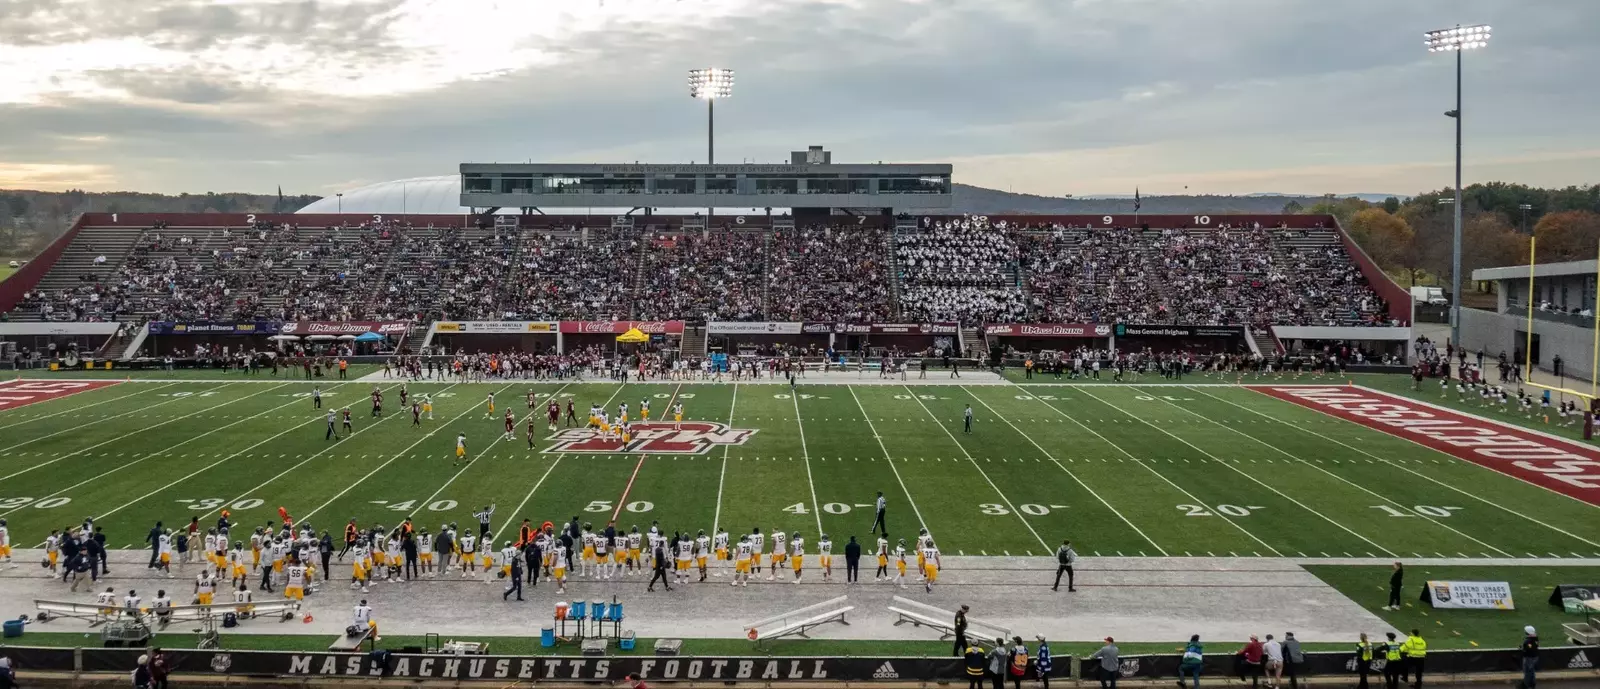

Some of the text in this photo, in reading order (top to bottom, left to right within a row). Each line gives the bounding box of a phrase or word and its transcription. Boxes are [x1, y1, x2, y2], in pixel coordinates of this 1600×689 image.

[112, 213, 117, 222] 1
[247, 214, 256, 223] 2
[373, 215, 383, 223] 3
[736, 216, 746, 224] 6
[857, 216, 867, 224] 7
[1103, 215, 1112, 224] 9
[1194, 216, 1210, 224] 10
[188, 324, 210, 332] planet
[187, 498, 265, 510] 30
[386, 500, 458, 511] 40
[583, 501, 655, 512] 50
[782, 502, 852, 514] 40
[979, 504, 1051, 515] 30
[1175, 504, 1251, 516] 20
[1370, 504, 1452, 517] 10
[291, 570, 301, 578] 56
[640, 660, 828, 678] FOOTBALL
